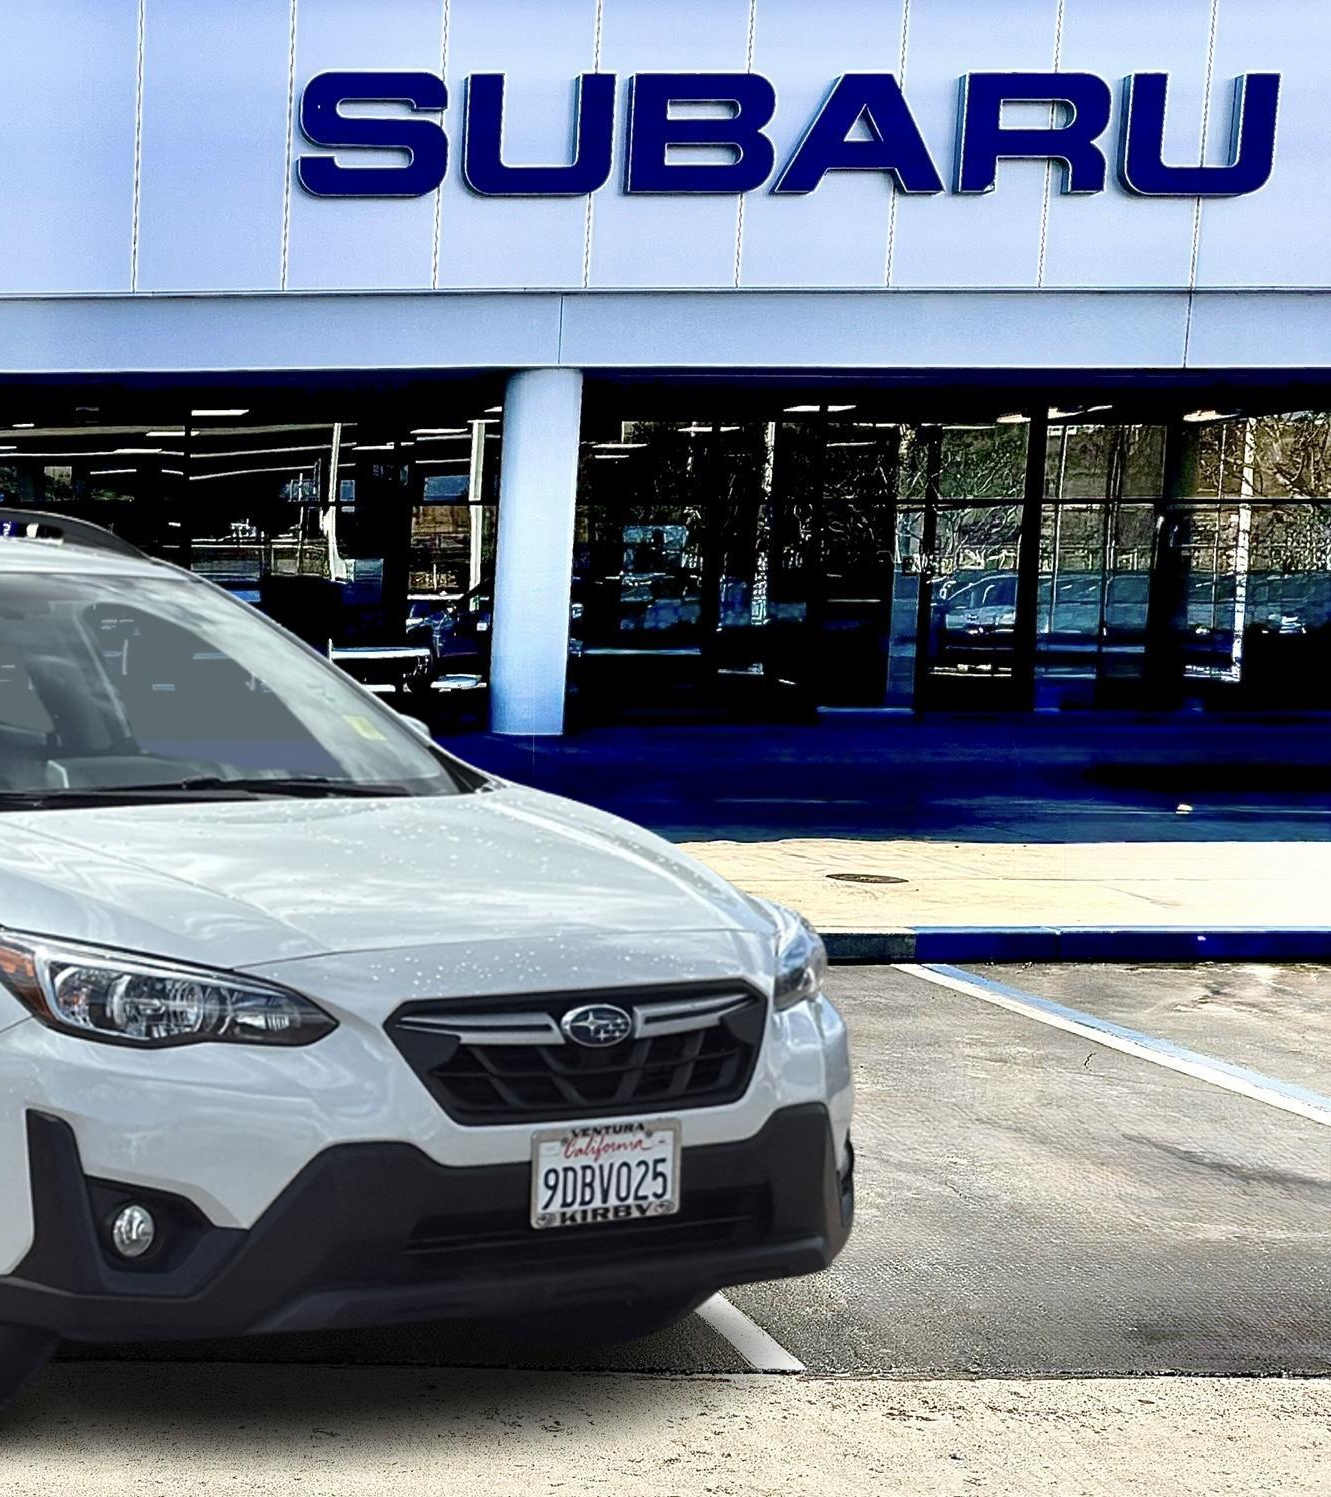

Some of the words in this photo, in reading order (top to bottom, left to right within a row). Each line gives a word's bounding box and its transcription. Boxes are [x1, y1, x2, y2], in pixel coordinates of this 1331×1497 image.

[297, 69, 1282, 198] SUBARU
[571, 1123, 645, 1138] VENTURA
[563, 1136, 652, 1162] California
[542, 1158, 668, 1211] 9DBV025
[560, 1202, 653, 1225] KIRBY
